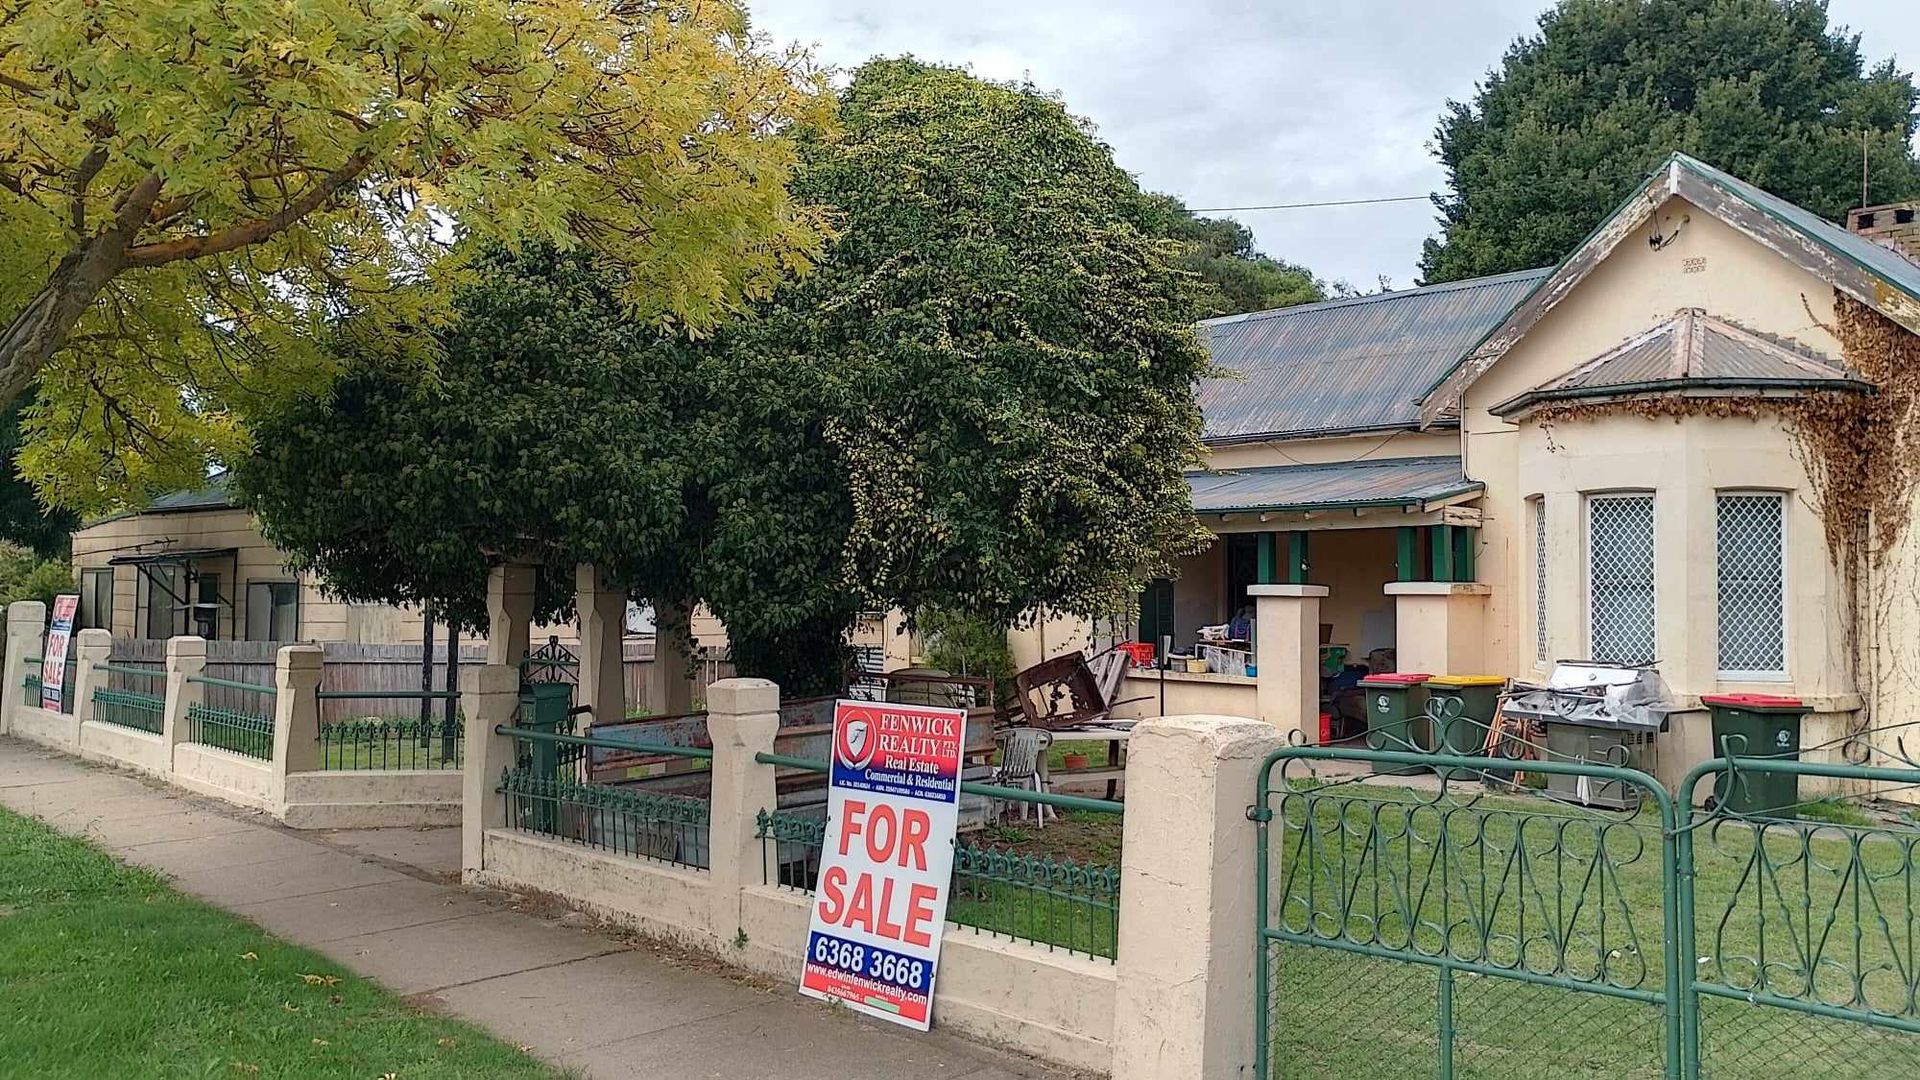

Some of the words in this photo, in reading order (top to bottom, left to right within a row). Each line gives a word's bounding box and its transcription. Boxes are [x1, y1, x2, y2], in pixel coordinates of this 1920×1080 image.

[49, 633, 65, 658] FOR
[43, 660, 63, 686] SALE
[880, 713, 955, 737] FENWICK
[879, 734, 941, 757] REALTY
[885, 755, 907, 771] Real
[908, 757, 940, 774] Estate
[864, 768, 906, 785] Commercial
[906, 773, 914, 786] &
[915, 774, 955, 791] Residential
[838, 799, 931, 872] FOR
[818, 866, 939, 948] SALE
[815, 936, 865, 972] 6368
[869, 950, 923, 989] 3668
[806, 962, 928, 1005] www.edwinfenwickrealty.com
